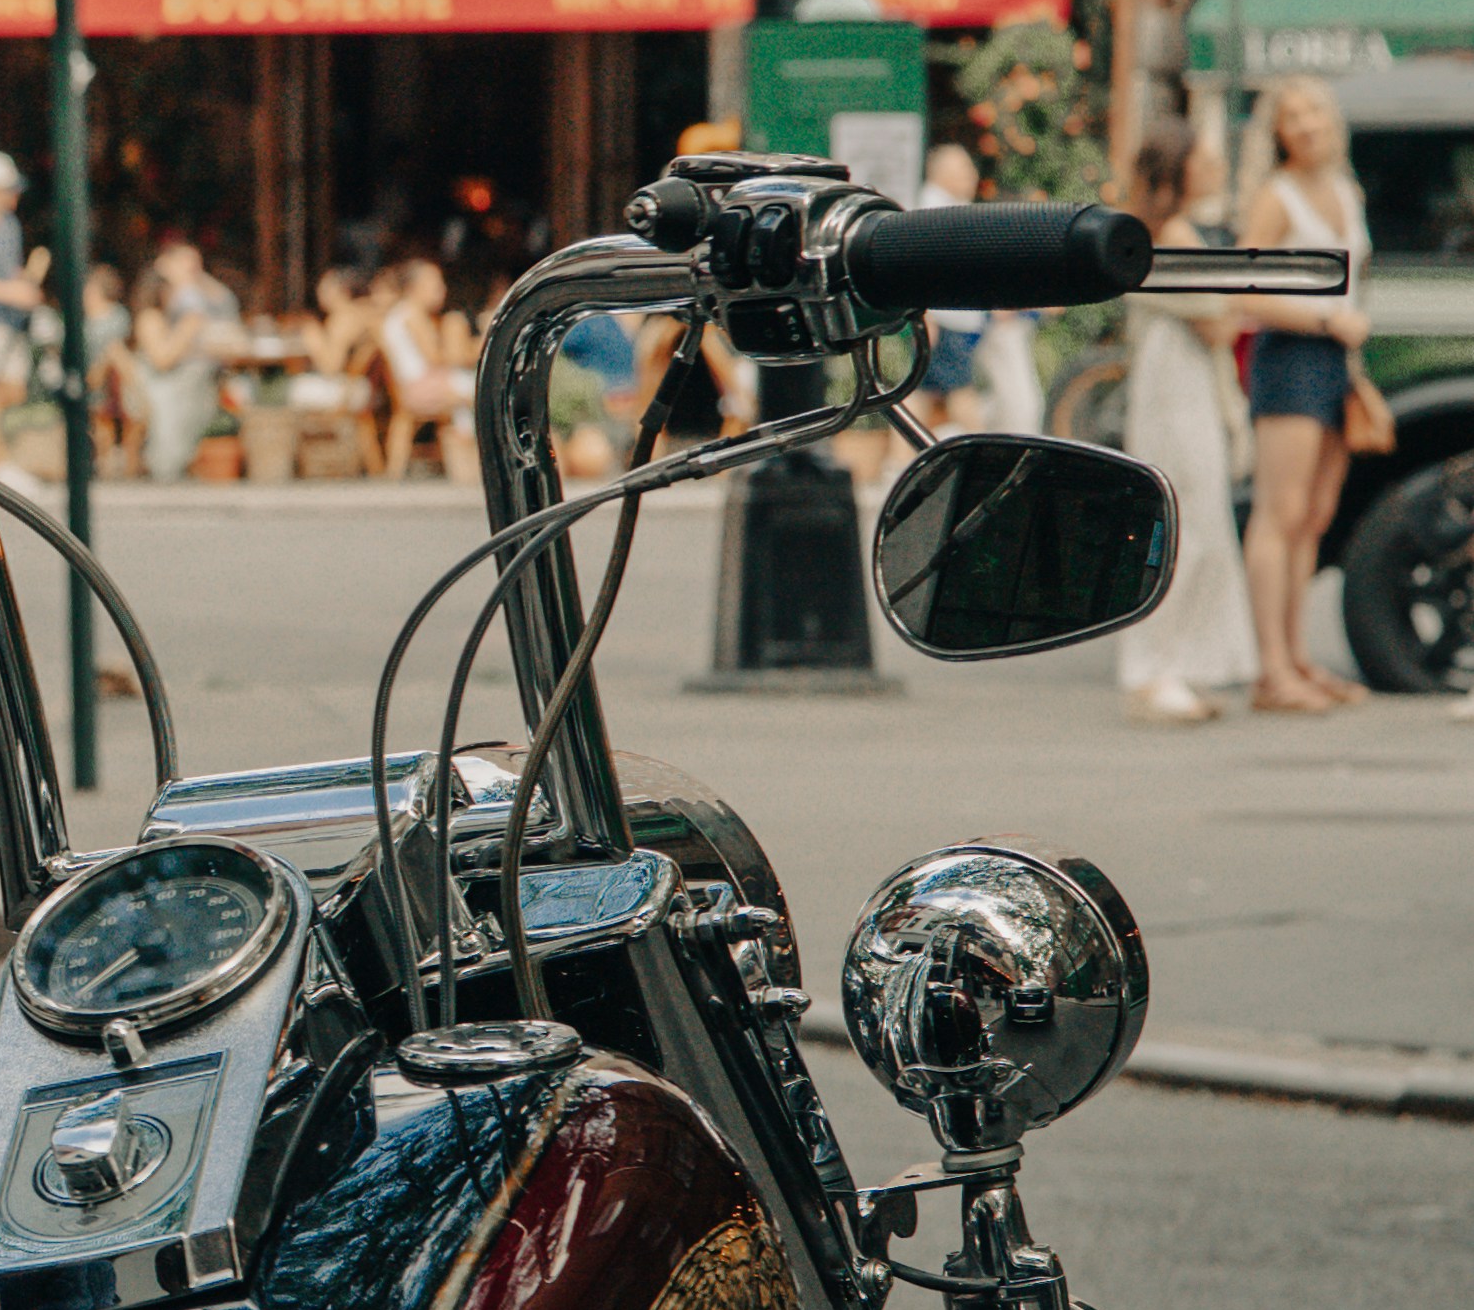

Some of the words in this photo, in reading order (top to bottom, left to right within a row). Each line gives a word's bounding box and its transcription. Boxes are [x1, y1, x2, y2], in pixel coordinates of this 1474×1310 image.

[156, 890, 177, 901] 60
[188, 888, 207, 899] 70
[126, 900, 147, 912] 50
[208, 895, 229, 907] 80
[221, 908, 242, 921] 90
[98, 916, 118, 928] 40
[215, 927, 243, 940] 100
[78, 936, 99, 948] 30
